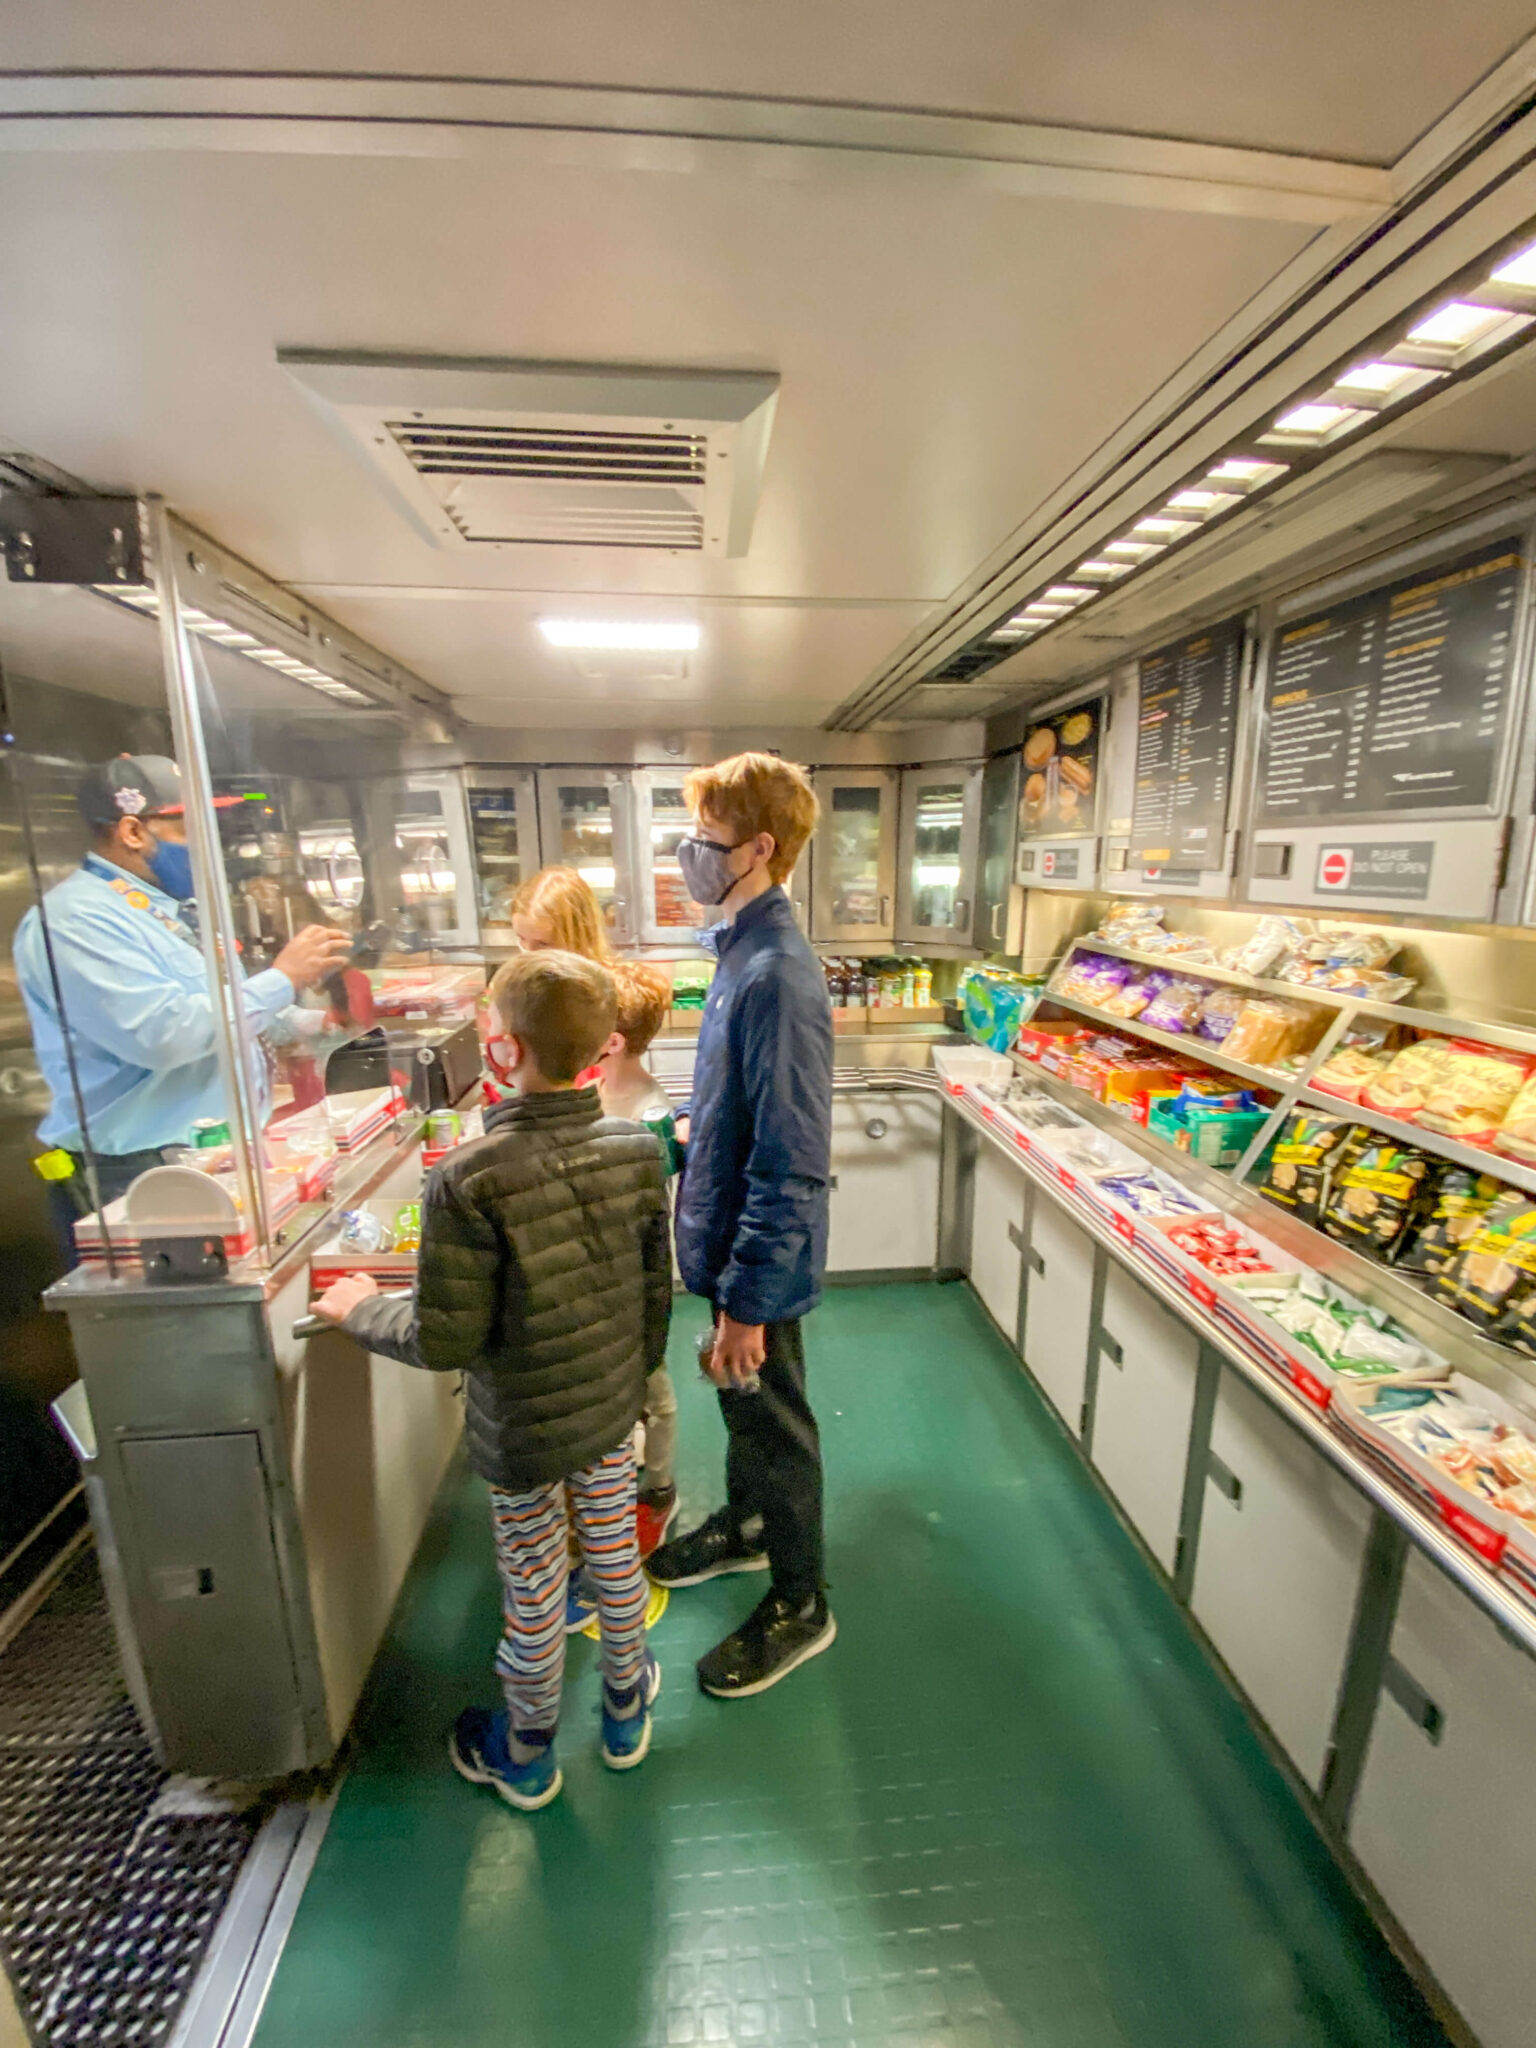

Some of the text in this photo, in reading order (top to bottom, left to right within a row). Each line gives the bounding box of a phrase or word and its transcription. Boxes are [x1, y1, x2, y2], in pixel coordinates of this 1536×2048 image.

[1370, 849, 1411, 861] PLEASE
[1353, 862, 1428, 874] DO NOT OPEN
